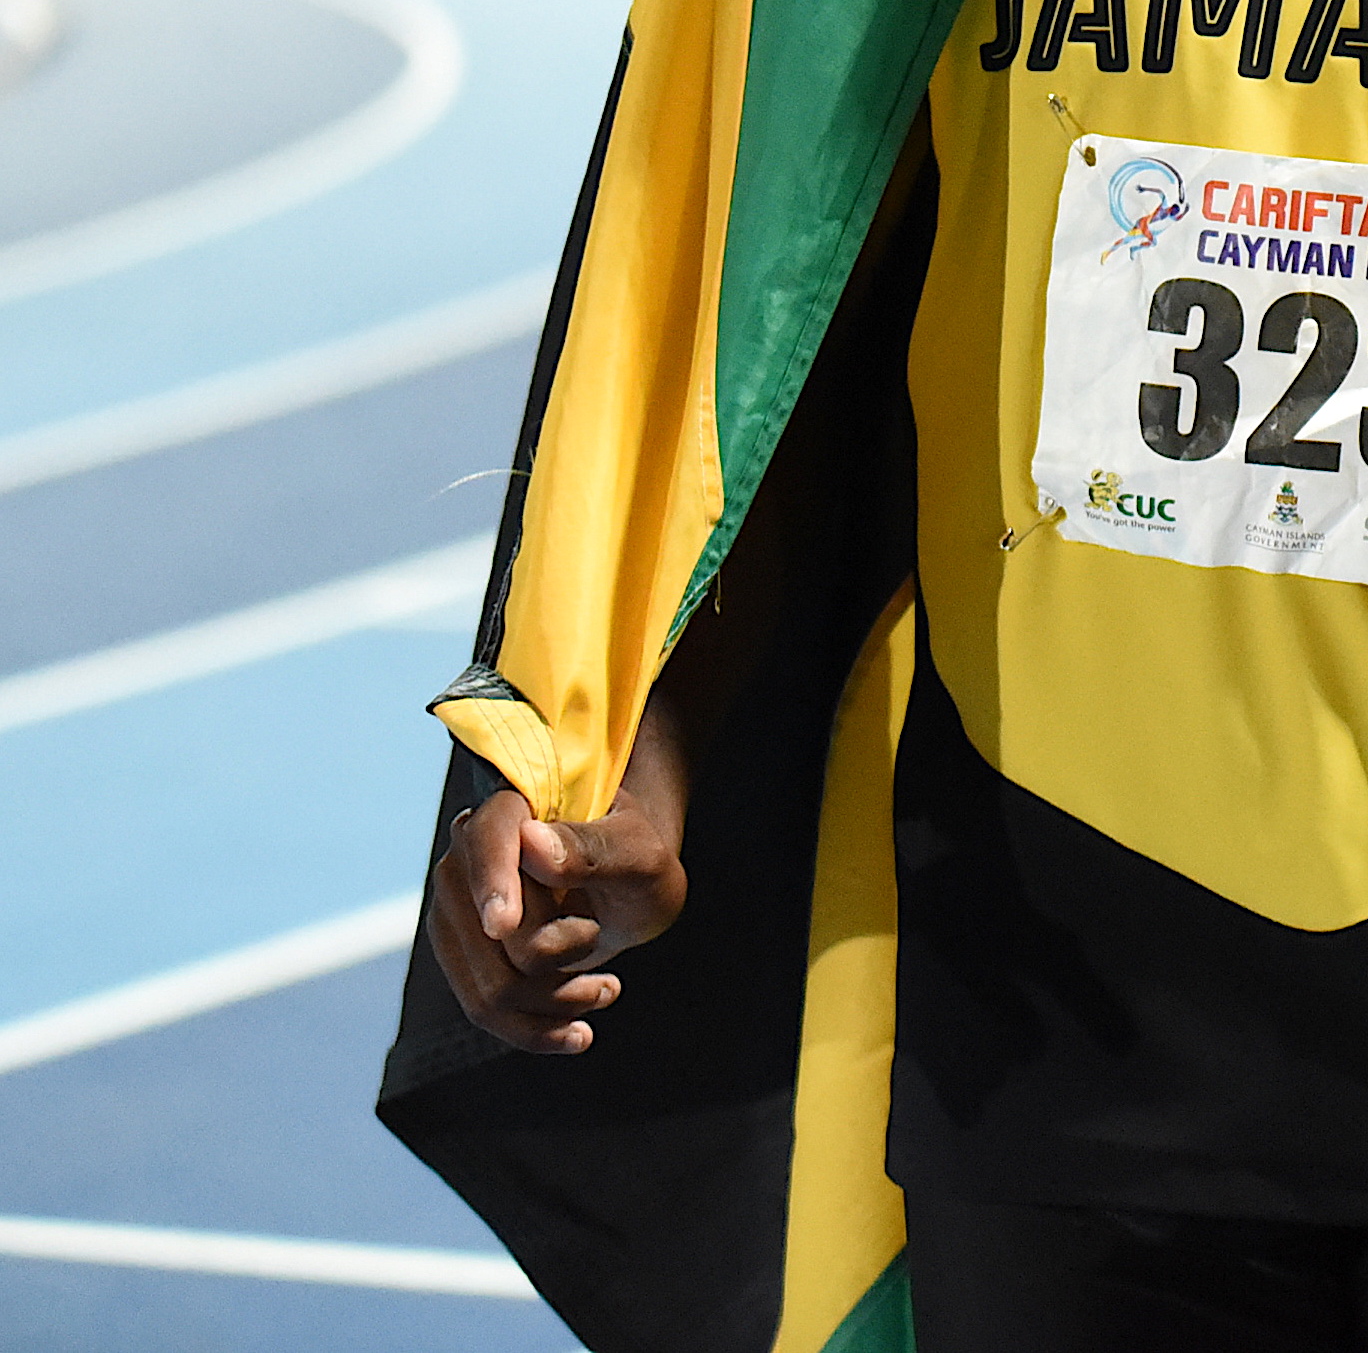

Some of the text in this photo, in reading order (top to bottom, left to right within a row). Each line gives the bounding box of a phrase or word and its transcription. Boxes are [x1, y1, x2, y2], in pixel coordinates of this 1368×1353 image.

[1197, 229, 1355, 278] CAYMAN
[1116, 493, 1176, 522] CUC
[1113, 518, 1128, 527] got
[1131, 520, 1145, 529] the
[1148, 523, 1176, 533] power
[1245, 524, 1325, 541] CAYMAN ISLANDS
[1245, 534, 1324, 551] GOVERNMENT
